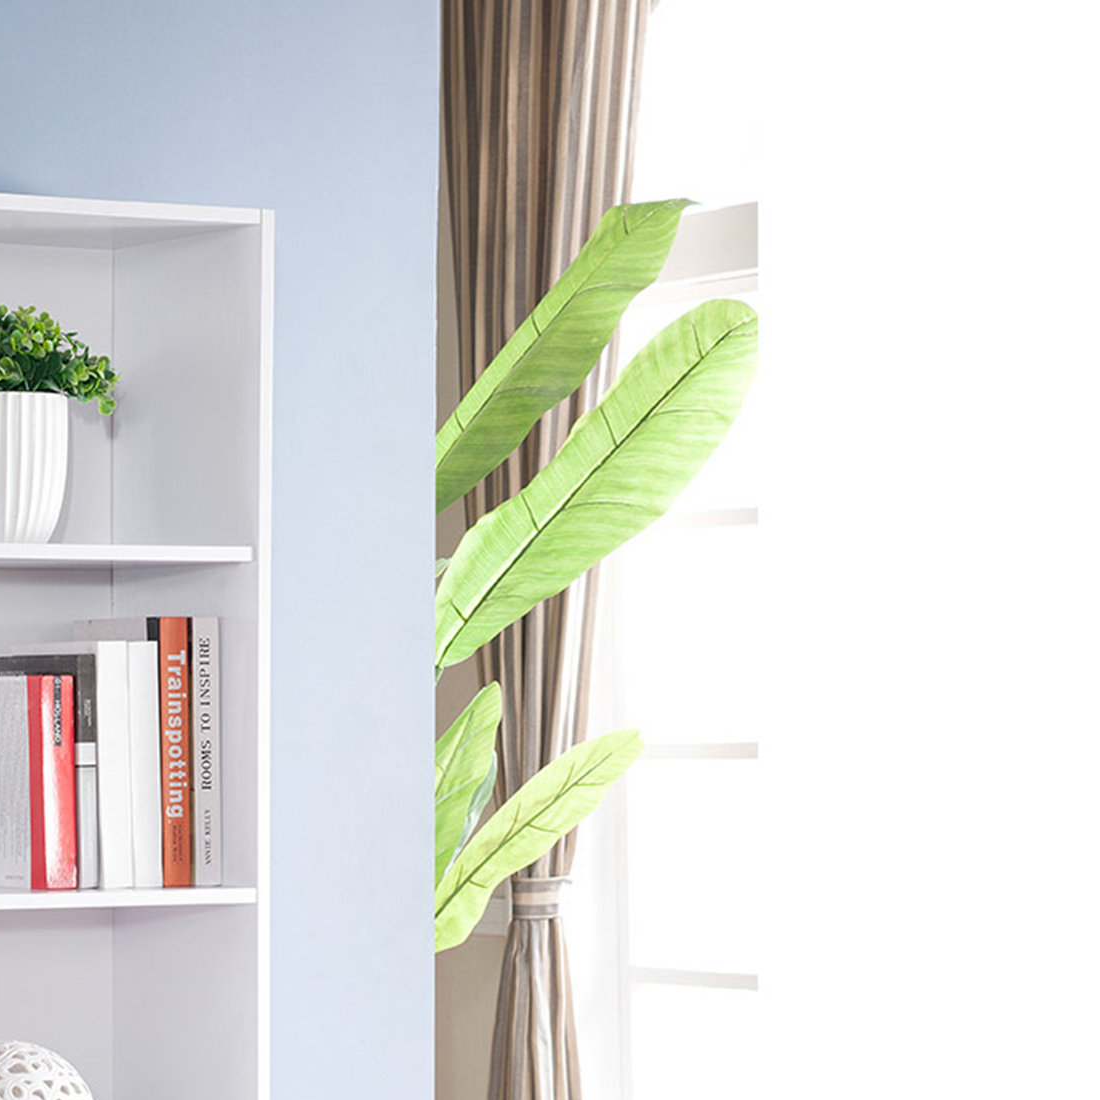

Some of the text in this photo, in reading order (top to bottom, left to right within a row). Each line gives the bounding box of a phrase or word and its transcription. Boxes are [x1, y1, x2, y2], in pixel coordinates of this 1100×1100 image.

[199, 637, 211, 706] INSPIRE
[200, 712, 212, 732] TO
[200, 739, 212, 791] ROOMS
